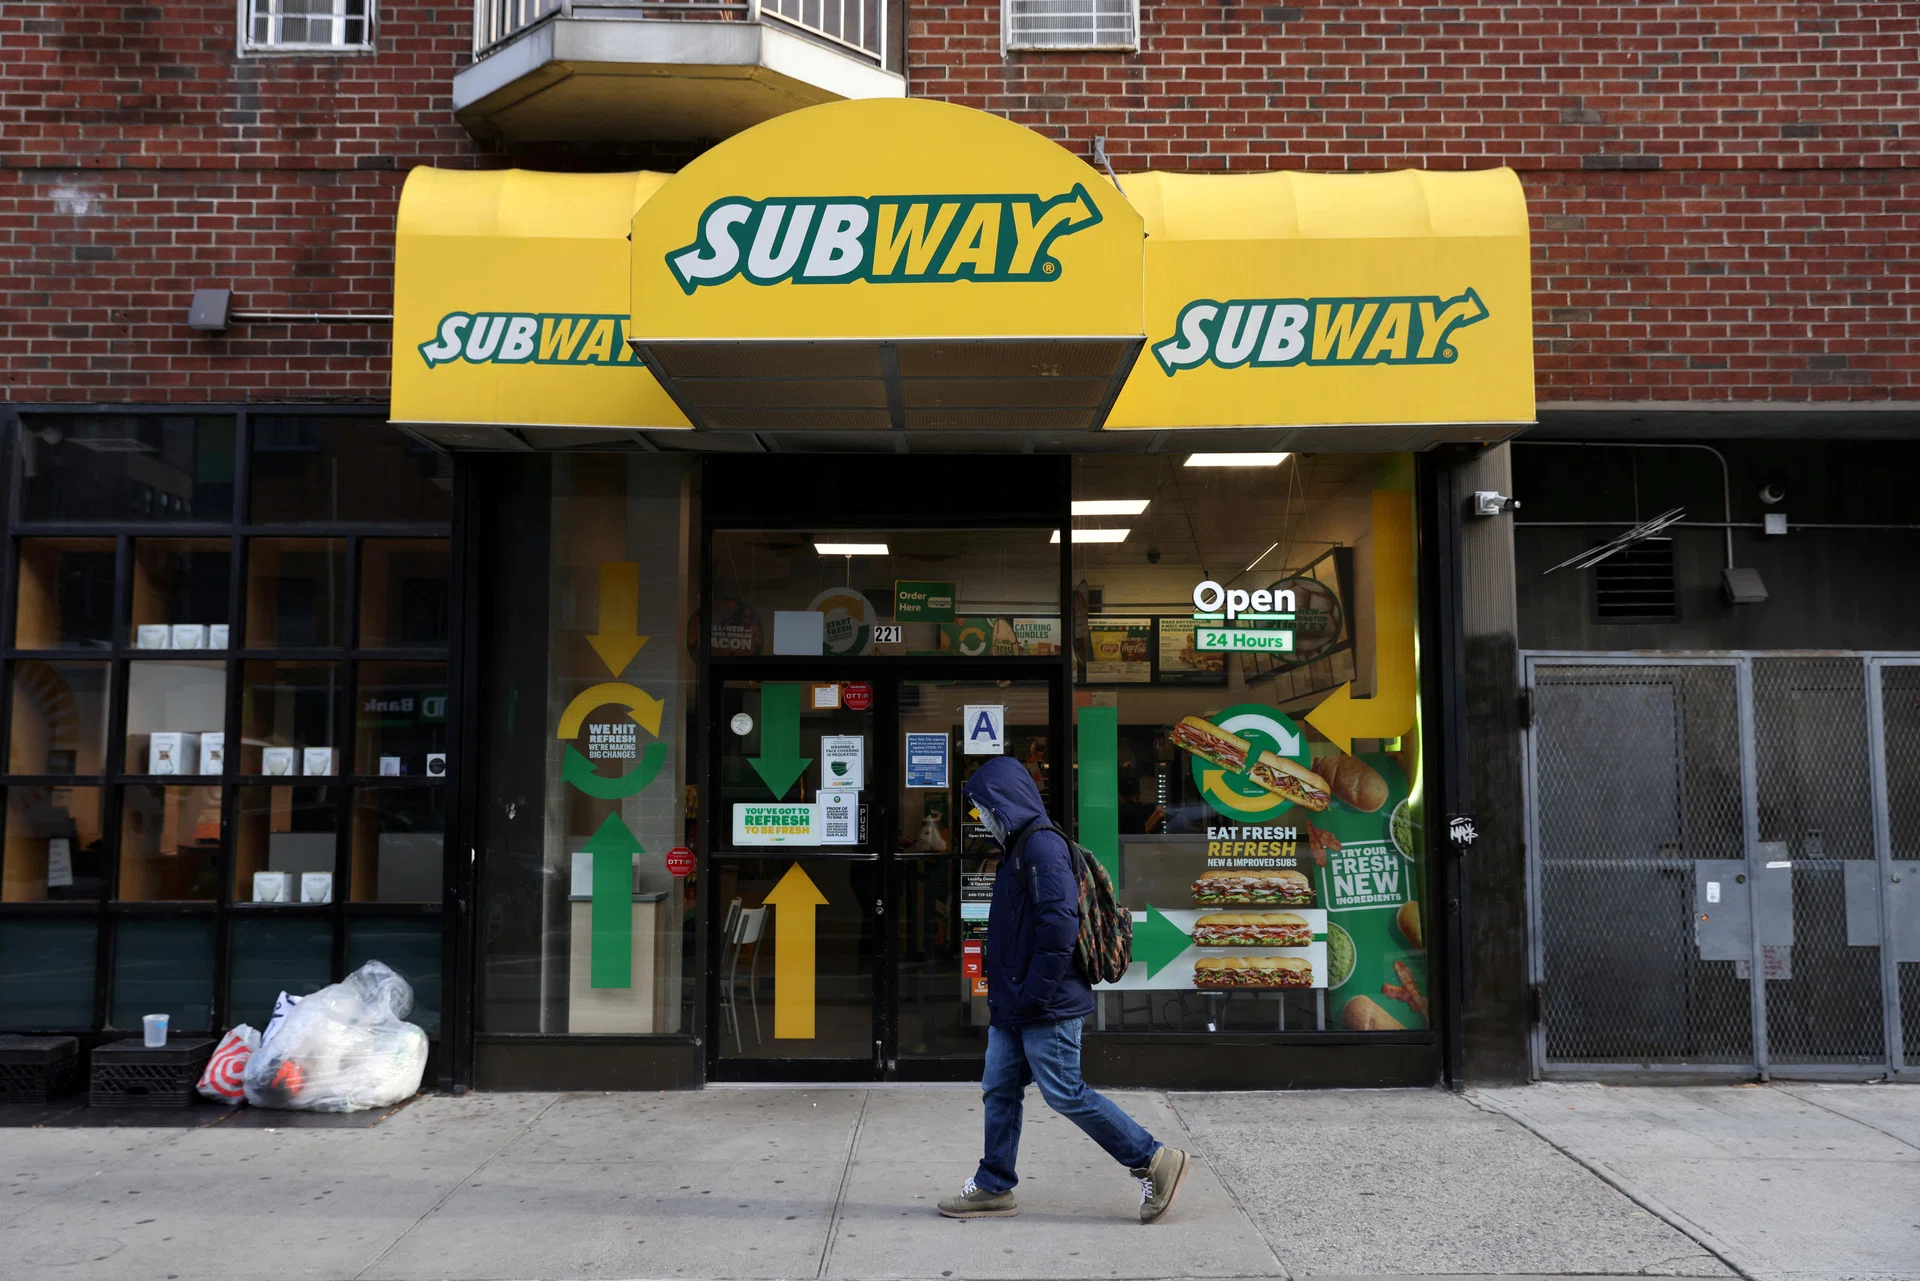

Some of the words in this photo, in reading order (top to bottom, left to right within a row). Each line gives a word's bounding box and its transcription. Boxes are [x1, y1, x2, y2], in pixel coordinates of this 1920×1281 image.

[672, 193, 1094, 284] SUBWAY
[1156, 294, 1483, 369] SUBWAY
[899, 591, 927, 600] Order
[1193, 580, 1296, 620] Open
[899, 603, 922, 612] Here
[827, 618, 852, 630] START
[1015, 624, 1052, 632] CATERING
[827, 625, 852, 636] FRESH
[875, 627, 899, 642] 221
[1206, 633, 1228, 647] 24
[1233, 633, 1284, 648] Hours
[589, 724, 610, 734] WE
[613, 724, 636, 734] HIT
[970, 710, 998, 741] A
[589, 735, 637, 743] REFRESH
[589, 751, 602, 759] BIG
[602, 751, 636, 759] CHANGES
[745, 815, 810, 826] REFRESH
[745, 826, 760, 834] TO
[761, 826, 775, 834] BE
[776, 826, 810, 834] FRESH
[1207, 826, 1239, 840] EAT
[1242, 826, 1297, 840] FRESH
[1207, 841, 1297, 857] REFRESH
[1340, 848, 1362, 858] TRY
[1362, 846, 1387, 856] OUR
[1207, 858, 1226, 867] NEW
[1226, 858, 1233, 867] &
[1233, 858, 1275, 867] IMPROVED
[1275, 858, 1297, 867] SUBS
[1331, 855, 1399, 875] FRESH
[1333, 871, 1400, 897] NEW
[1336, 893, 1402, 905] INGREDIENTS
